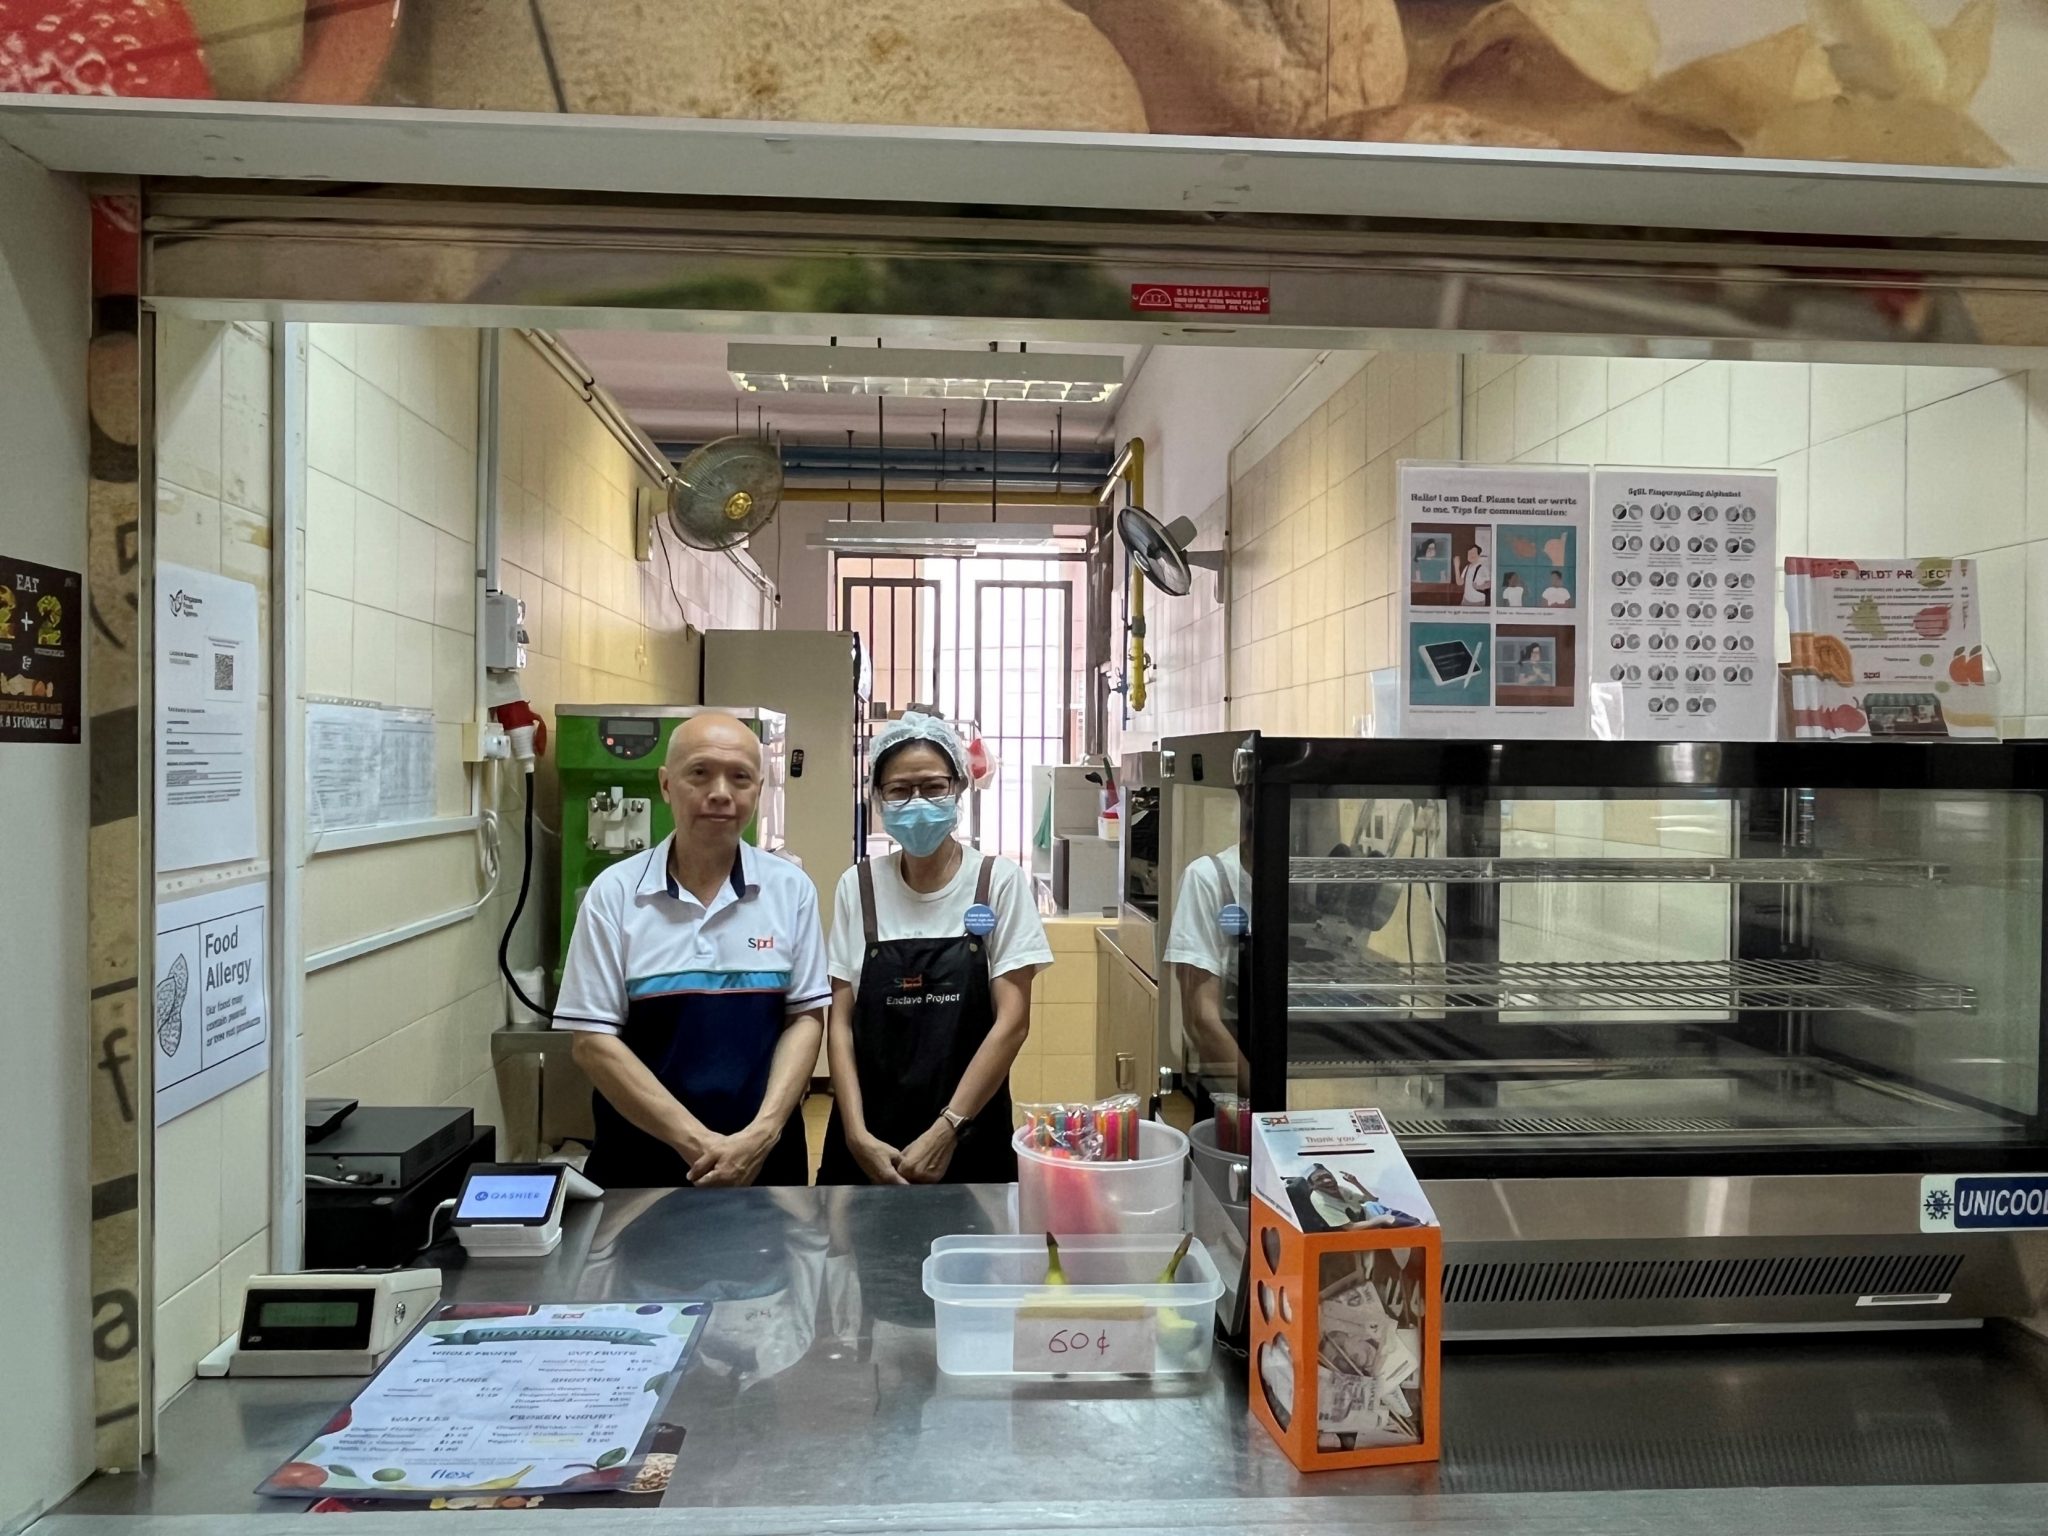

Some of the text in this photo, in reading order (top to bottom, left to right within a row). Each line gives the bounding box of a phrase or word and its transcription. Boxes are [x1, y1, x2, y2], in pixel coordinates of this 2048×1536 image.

[1452, 505, 1472, 516] Tips
[1474, 505, 1487, 515] for
[1897, 569, 1953, 579] PRJECT
[16, 574, 39, 593] EAT
[205, 925, 239, 958] Food
[747, 936, 774, 951] spd
[206, 958, 252, 991] Allergy
[926, 993, 960, 1005] Project
[1261, 1115, 1289, 1127] spd
[490, 1191, 541, 1200] QASHIER
[430, 1468, 475, 1480] flex
